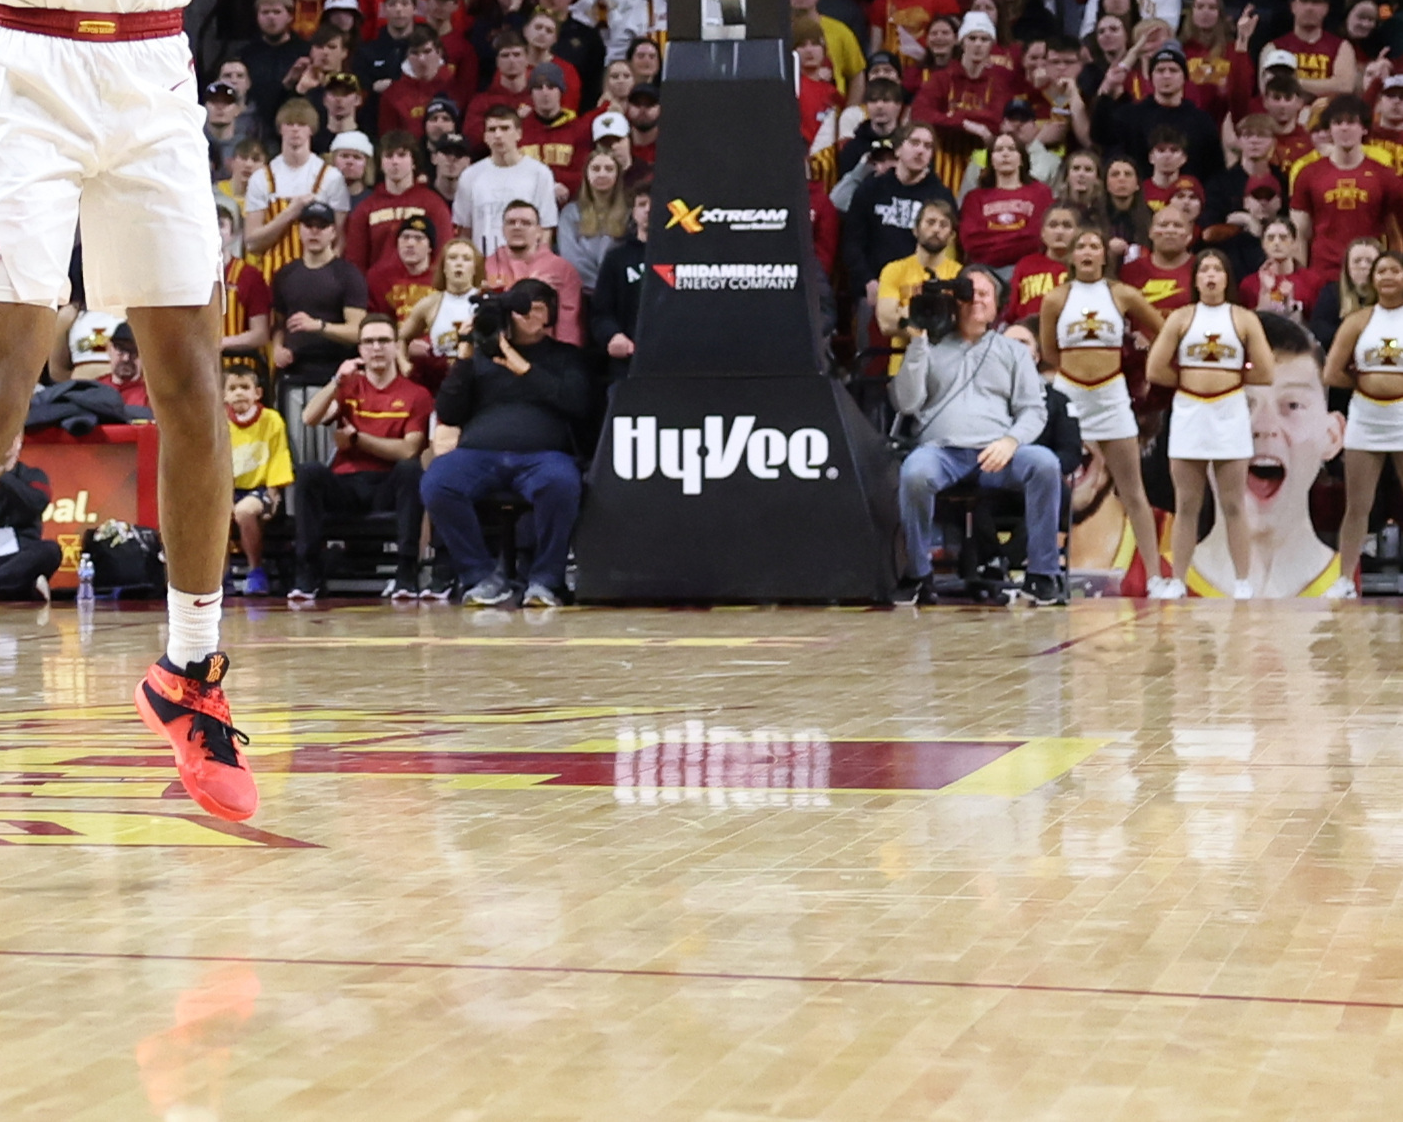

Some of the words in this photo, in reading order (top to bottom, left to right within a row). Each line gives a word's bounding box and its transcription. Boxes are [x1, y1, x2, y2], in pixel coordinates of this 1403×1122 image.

[699, 208, 789, 224] XTREAM
[675, 264, 798, 278] MIDAMERICAN
[675, 278, 726, 291] ENERGY
[728, 278, 797, 290] COMPANY
